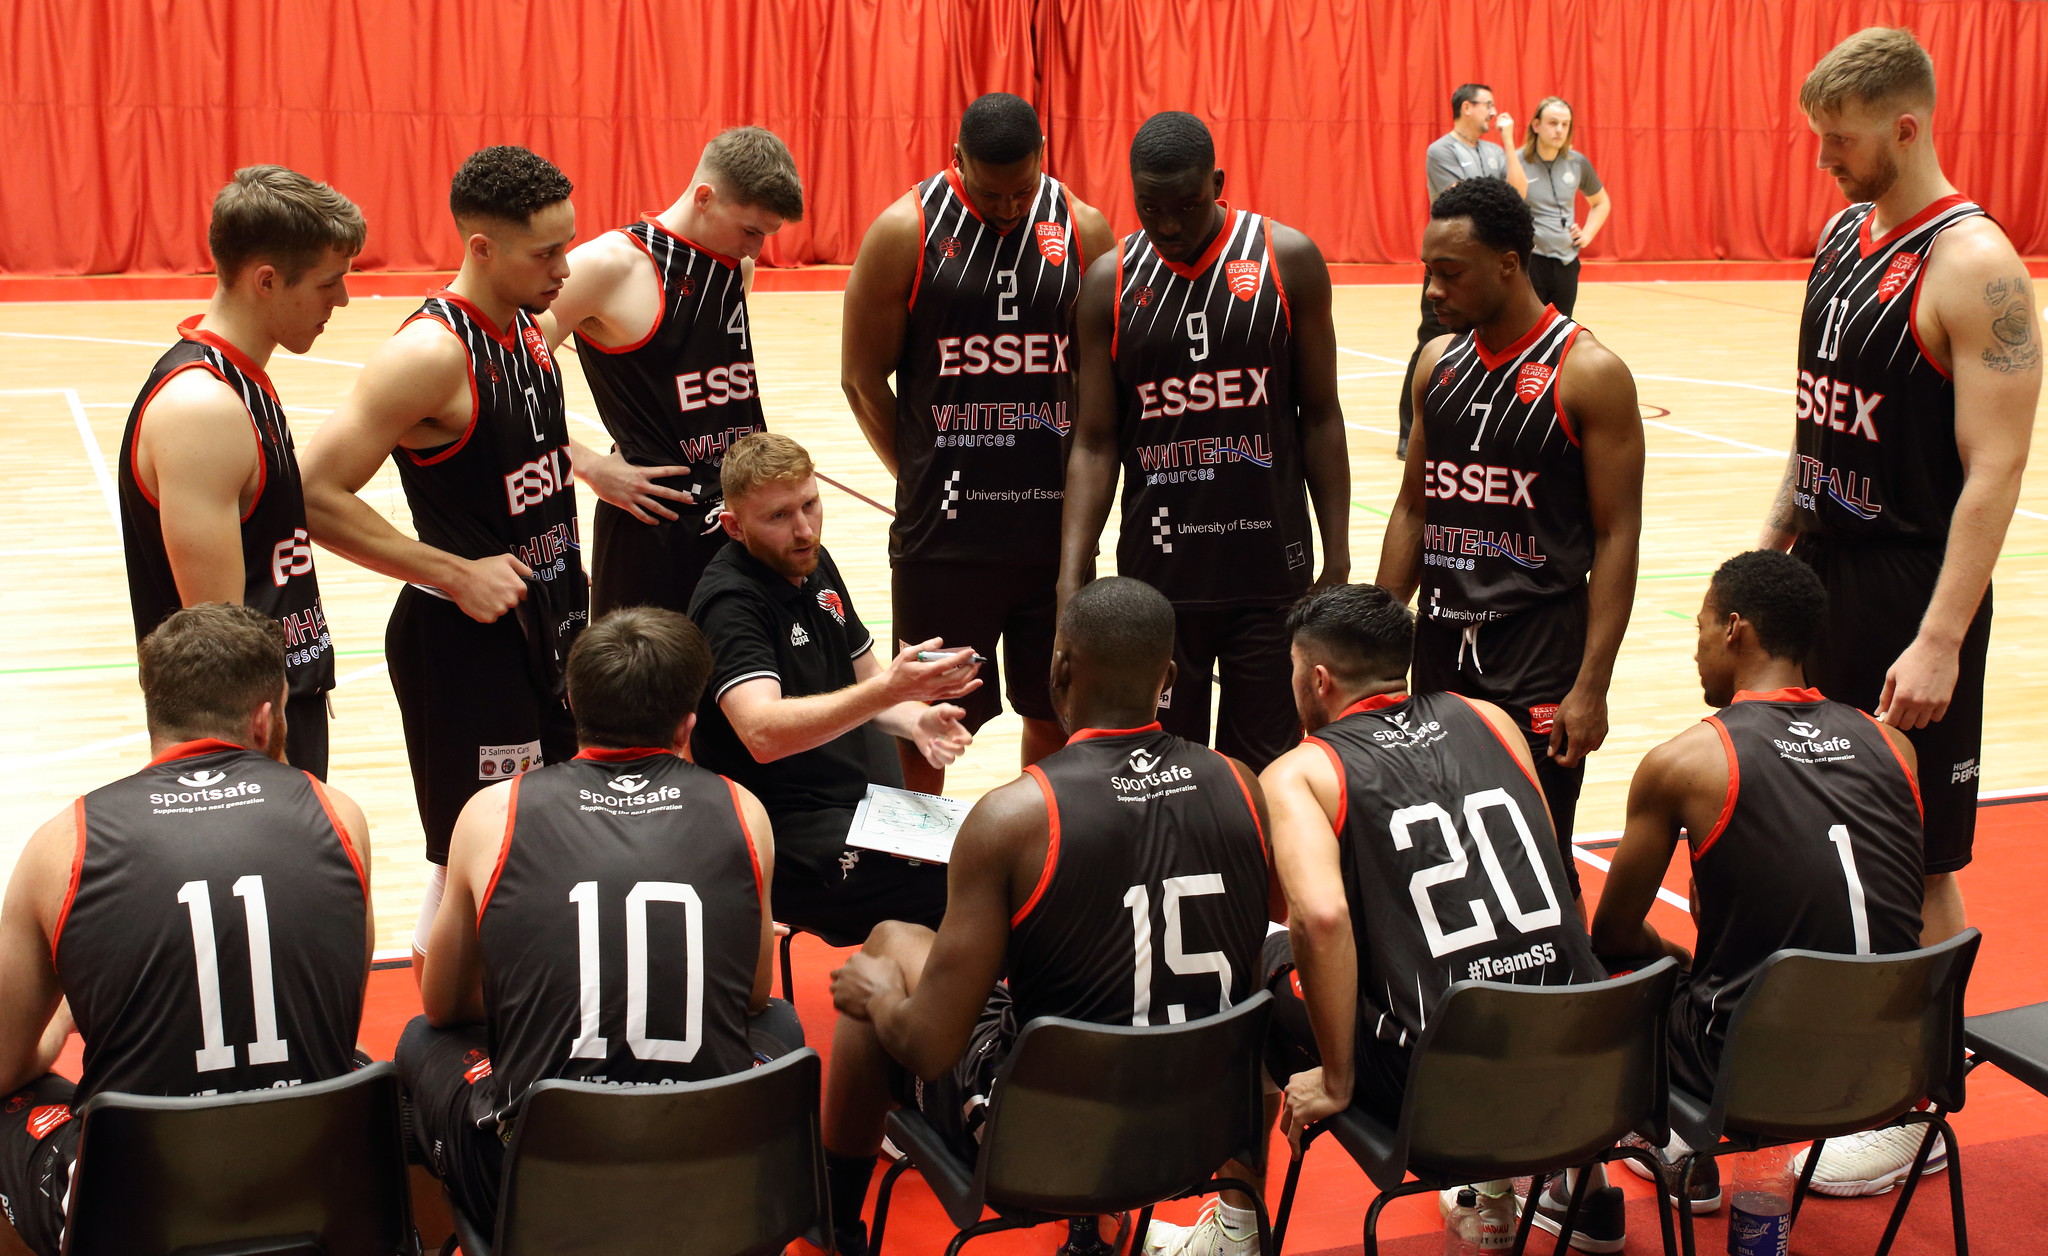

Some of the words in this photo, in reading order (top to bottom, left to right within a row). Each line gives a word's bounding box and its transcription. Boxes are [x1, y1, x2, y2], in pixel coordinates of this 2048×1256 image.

[996, 270, 1019, 321] 2
[727, 301, 747, 350] 4
[1186, 311, 1209, 361] 9
[1817, 297, 1850, 362] 13
[937, 333, 1070, 377] ESSEX
[1524, 364, 1549, 373] ESSEX
[1136, 367, 1270, 420] ESSEX
[1796, 369, 1885, 442] SSEX
[1470, 402, 1493, 452] 7
[965, 489, 1020, 503] University
[1021, 489, 1033, 500] of
[1033, 488, 1065, 500] Essex
[1424, 460, 1540, 509] ESSEX
[1178, 521, 1226, 535] University
[1227, 519, 1238, 531] of
[1240, 519, 1272, 530] Essex
[1477, 610, 1487, 621] of
[488, 748, 516, 756] Salmon
[1773, 736, 1852, 754] sportsafe
[149, 781, 262, 807] sportsafe
[579, 785, 681, 808] sportsafe
[1110, 765, 1193, 794] sportsafe
[1165, 784, 1198, 796] generation
[152, 807, 194, 815] Supporting
[208, 802, 225, 810] next
[225, 797, 265, 809] generation
[646, 804, 683, 814] generation
[1388, 787, 1561, 959] 20
[1828, 824, 1878, 955] 1
[569, 881, 704, 1063] 10
[1123, 873, 1233, 1027] 15
[1468, 942, 1557, 981] #TeamS5
[177, 875, 289, 1073] 11
